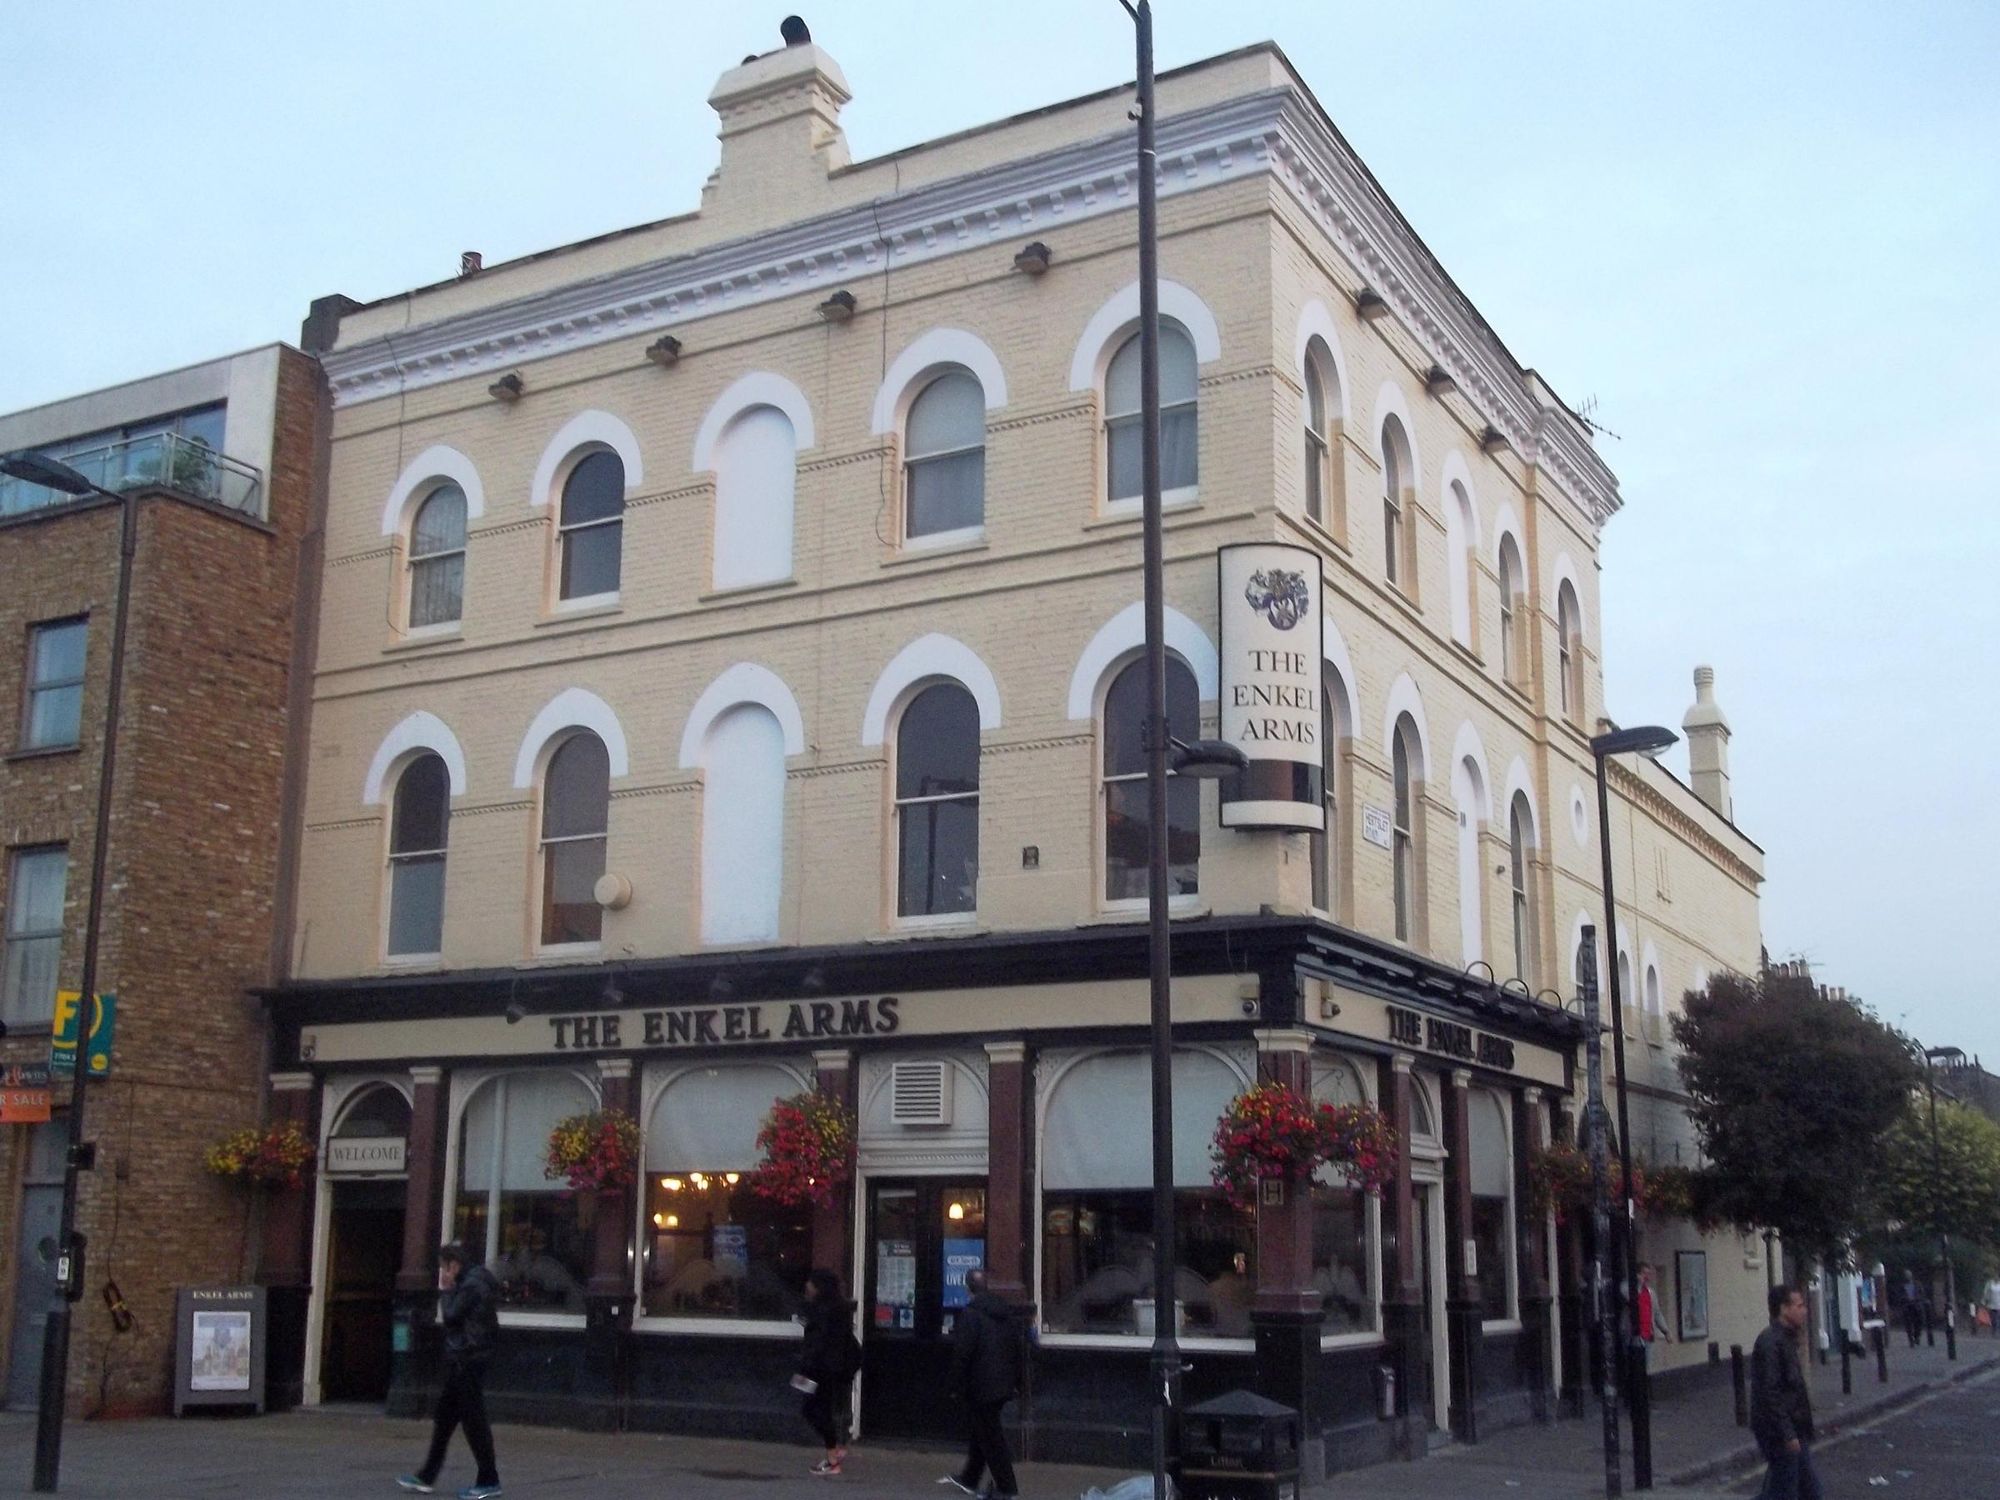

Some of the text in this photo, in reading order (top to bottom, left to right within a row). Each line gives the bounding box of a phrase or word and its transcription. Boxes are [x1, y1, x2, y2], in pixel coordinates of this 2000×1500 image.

[1248, 650, 1307, 676] THE
[1233, 684, 1319, 712] ENKEL
[1241, 719, 1315, 745] ARMS
[549, 997, 899, 1050] THE ENKEL ARMS
[1386, 1004, 1423, 1046] THE
[14, 1094, 45, 1105] SALE
[333, 1146, 400, 1161] WELCOME
[193, 1290, 255, 1300] ENKEL ARMS
